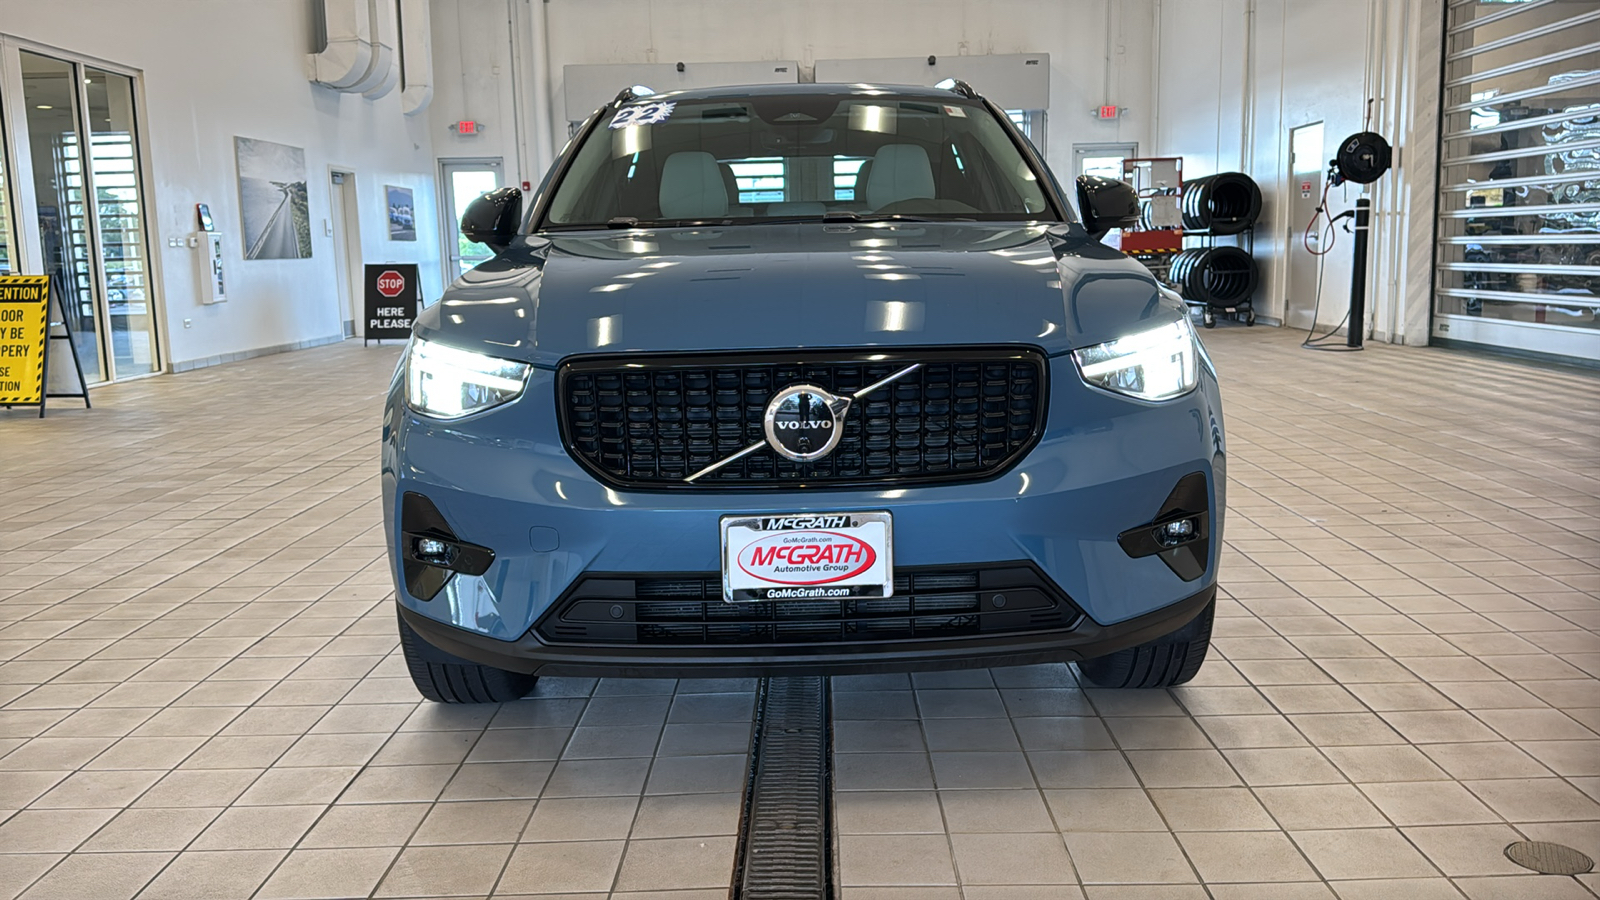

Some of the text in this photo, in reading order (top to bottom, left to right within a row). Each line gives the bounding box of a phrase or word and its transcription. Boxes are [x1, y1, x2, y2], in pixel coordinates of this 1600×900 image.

[1101, 105, 1116, 118] EXIT
[379, 279, 403, 289] STOP
[1, 309, 24, 322] OOR
[377, 307, 405, 317] HERE
[370, 319, 411, 329] PLEASE
[10, 327, 25, 340] BE
[776, 420, 832, 430] VOLVO
[783, 536, 832, 544] GoMcGrath.com
[773, 564, 849, 573] Automotive Group
[767, 588, 850, 599] GoMcGrath.com
